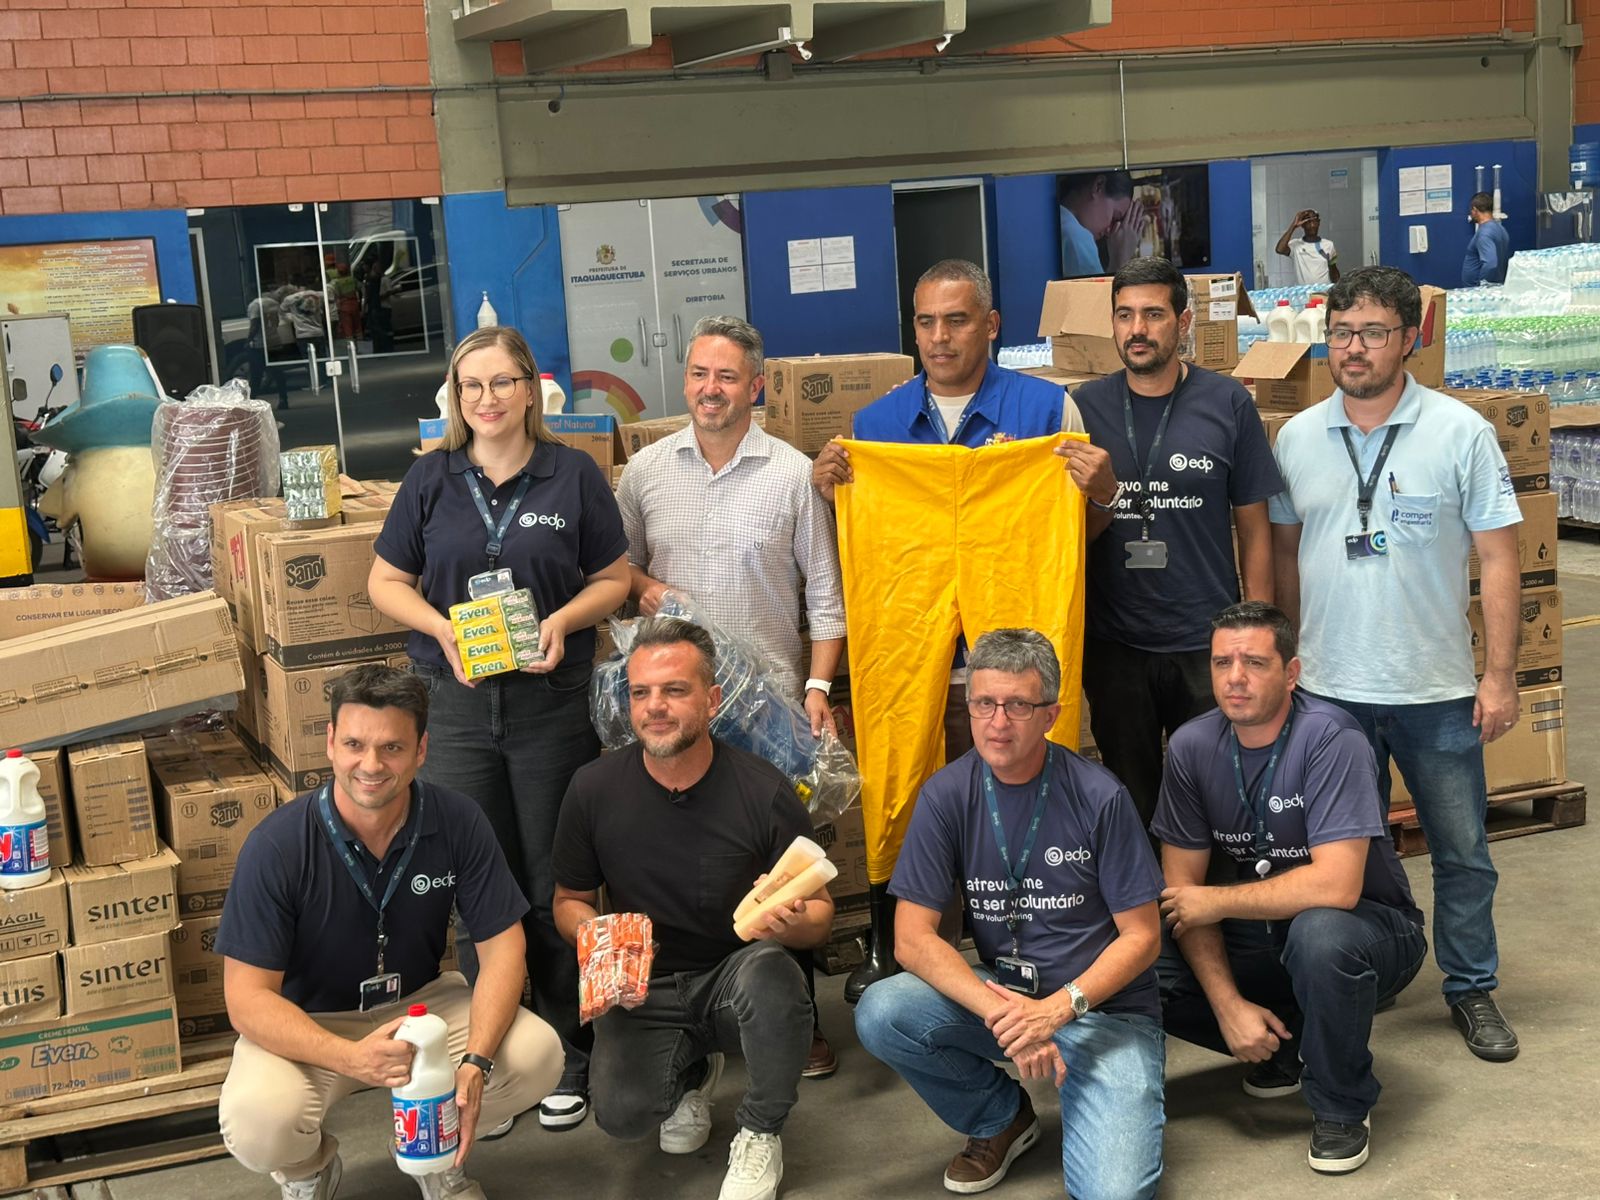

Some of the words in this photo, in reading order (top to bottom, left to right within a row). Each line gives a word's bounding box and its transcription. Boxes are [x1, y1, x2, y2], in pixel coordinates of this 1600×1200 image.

[671, 257, 717, 267] SECRETARIA
[718, 256, 729, 264] DE
[570, 270, 646, 284] ITAQUAQUECETUBA
[663, 268, 700, 278] SERVIÇOS
[701, 266, 738, 275] URBANOS
[685, 294, 726, 303] DIRETORIA
[802, 376, 834, 401] Sanol
[564, 419, 596, 430] Natural
[1188, 455, 1214, 474] edp
[1144, 495, 1203, 509] oluntário
[538, 513, 566, 531] edp
[1400, 511, 1433, 521] compet
[285, 557, 326, 587] Sanol
[15, 612, 62, 622] CONSERVAR
[63, 610, 75, 618] EM
[76, 608, 101, 617] LUGAR
[102, 607, 123, 615] SECO
[458, 606, 490, 622] Even
[1520, 600, 1541, 619] anol
[463, 624, 496, 640] Even
[307, 651, 334, 661] Contém
[341, 646, 374, 656] unidades
[374, 644, 383, 652] de
[383, 641, 403, 651] 2000
[467, 642, 501, 658] Even
[471, 660, 506, 676] Even
[210, 802, 243, 827] Sanol
[1064, 845, 1091, 865] edp
[87, 893, 175, 923] sinter
[969, 898, 980, 909] a
[983, 899, 1006, 911] ser
[972, 911, 985, 920] EDP
[79, 957, 166, 988] sinter
[38, 1029, 62, 1040] CREME
[62, 1025, 90, 1036] DENTAL
[31, 1042, 92, 1068] Even
